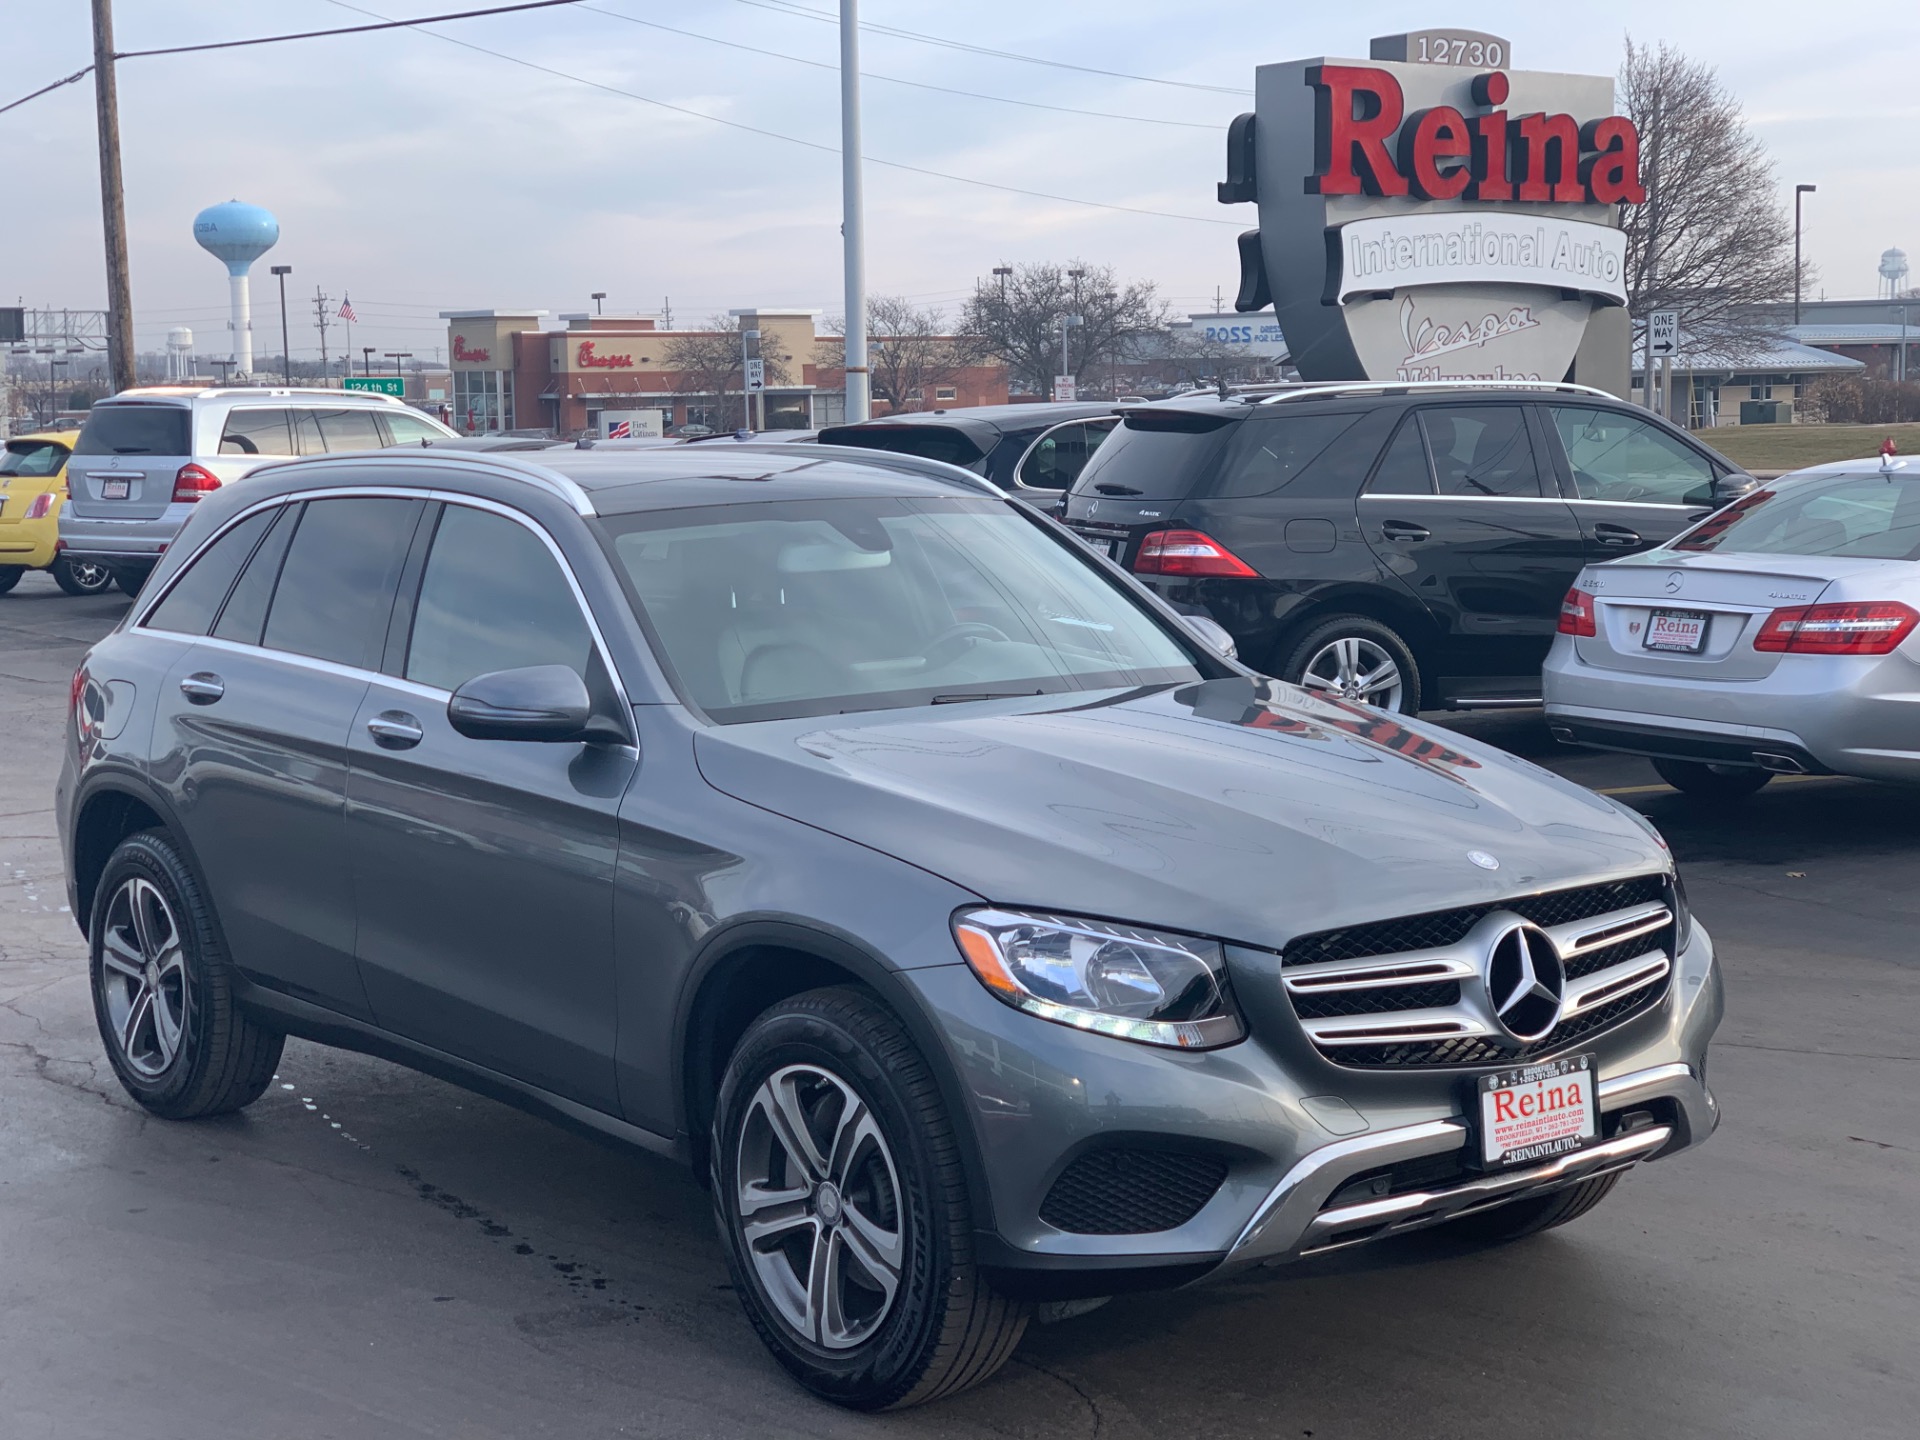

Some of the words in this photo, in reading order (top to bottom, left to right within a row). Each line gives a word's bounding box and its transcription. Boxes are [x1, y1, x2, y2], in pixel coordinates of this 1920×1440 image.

[1417, 36, 1503, 67] 12730
[1317, 65, 1646, 205] Reina
[1350, 222, 1545, 278] International
[1551, 229, 1620, 283] Auto
[1653, 314, 1674, 326] ONE
[1400, 294, 1540, 366] Vespa
[1653, 327, 1674, 339] WAY
[750, 361, 761, 370] ONE
[750, 370, 762, 378] WAY
[386, 383, 398, 392] St
[632, 421, 648, 429] First
[632, 430, 658, 438] Citizens
[1654, 617, 1699, 635] Reina
[1492, 1081, 1583, 1123] Reina
[1494, 1108, 1585, 1135] www.reinaintlauto.com
